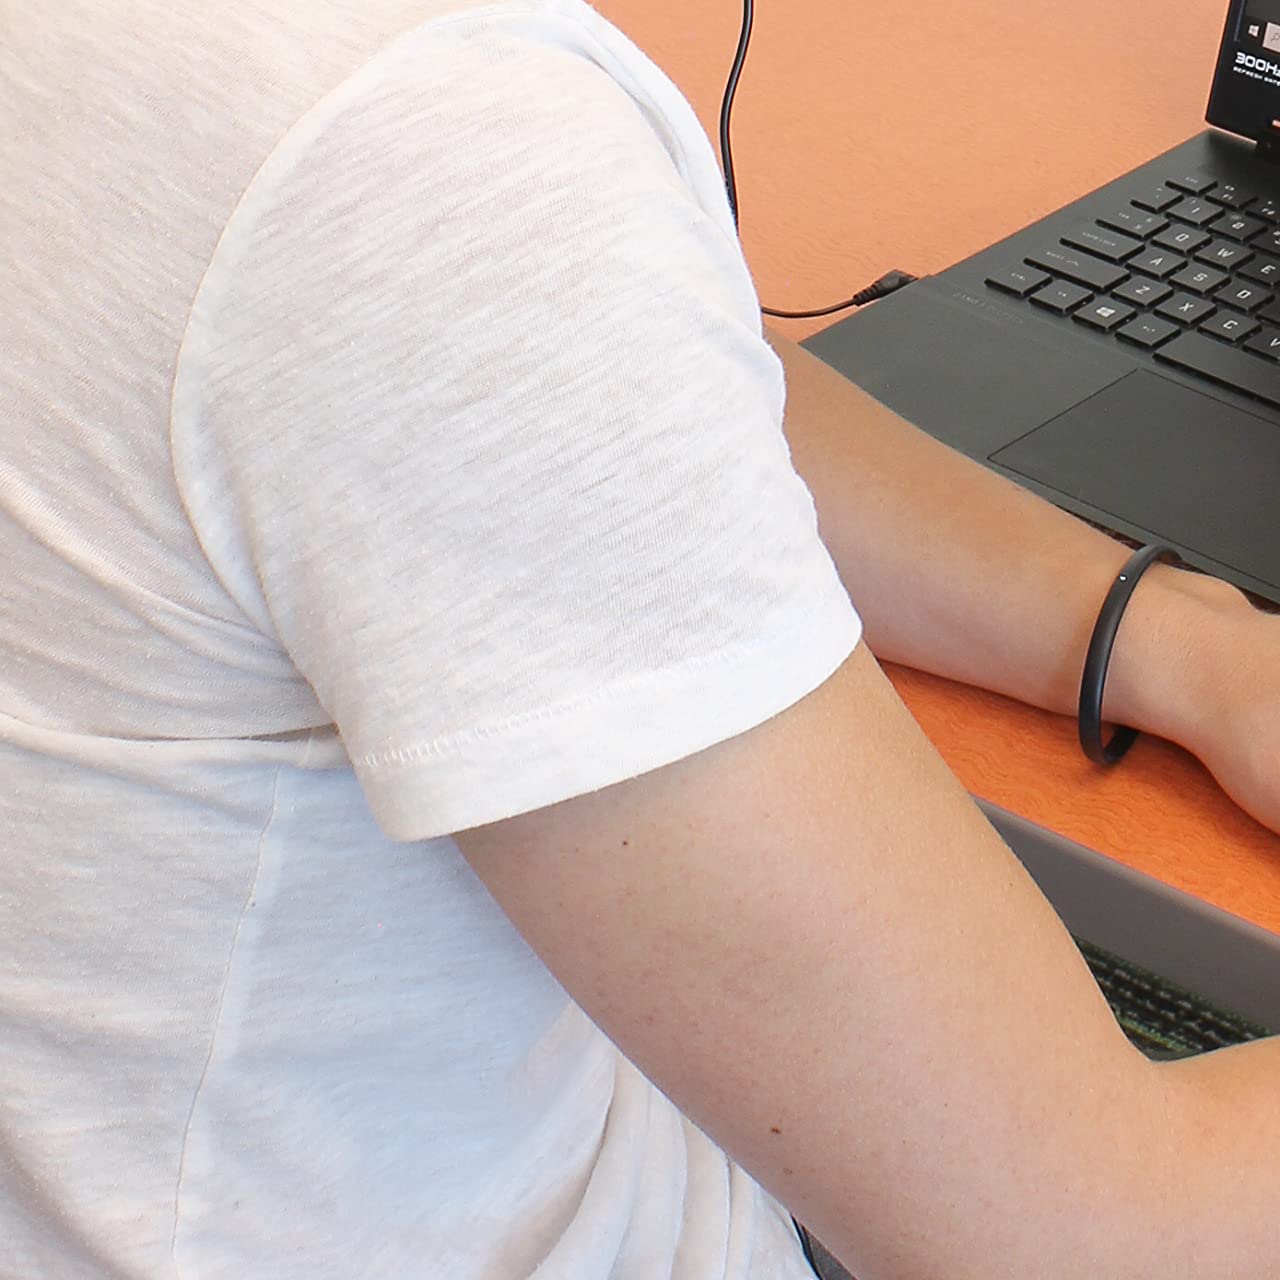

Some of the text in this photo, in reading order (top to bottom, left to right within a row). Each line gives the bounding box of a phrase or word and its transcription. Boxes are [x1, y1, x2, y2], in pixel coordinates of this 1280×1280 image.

[1218, 248, 1234, 258] W
[1150, 257, 1163, 266] A
[1260, 265, 1275, 275] E
[1193, 273, 1207, 282] S
[1136, 286, 1150, 295] Z
[1179, 302, 1193, 312] X
[1223, 320, 1238, 330] C
